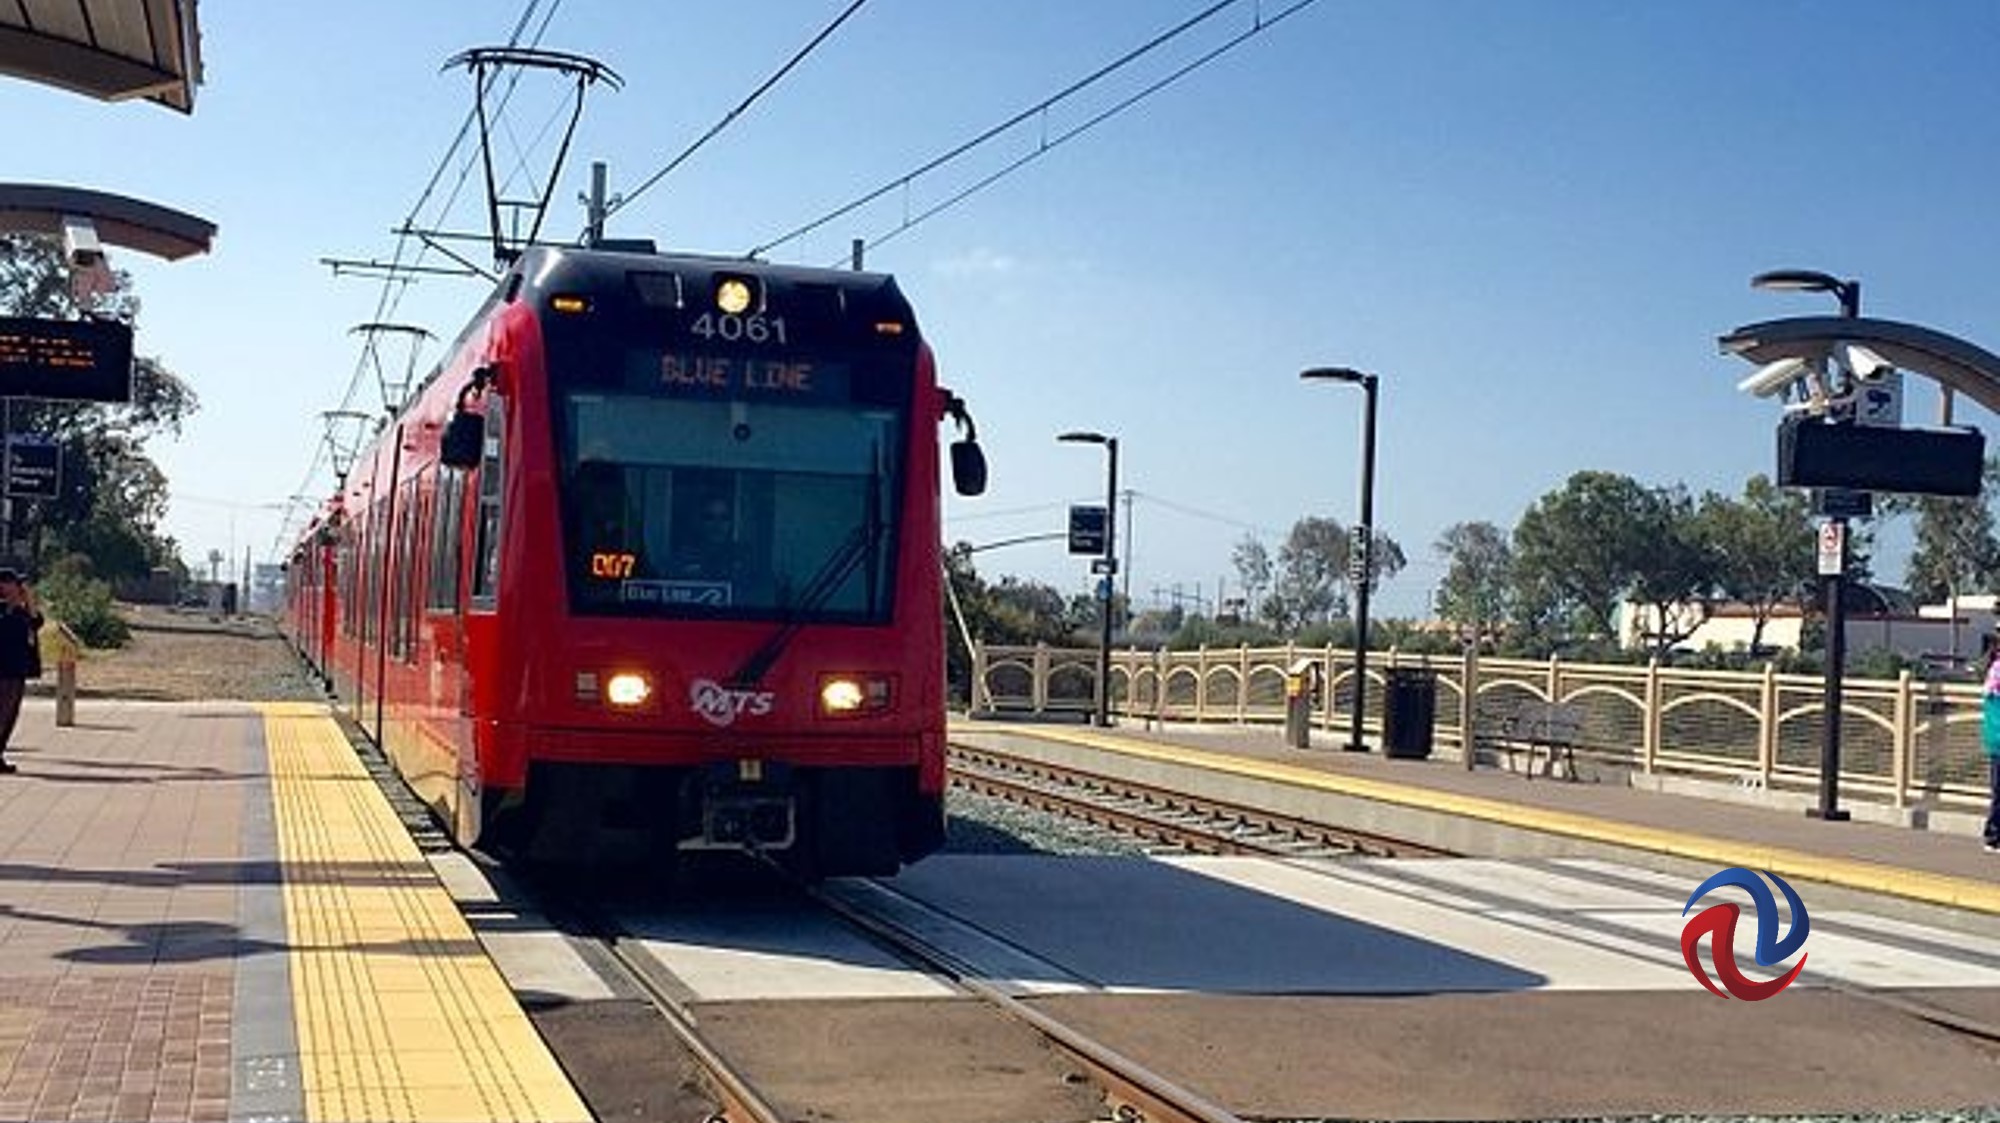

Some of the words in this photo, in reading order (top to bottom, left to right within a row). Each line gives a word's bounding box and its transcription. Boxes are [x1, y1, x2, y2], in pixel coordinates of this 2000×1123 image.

[691, 312, 786, 344] 4061
[661, 355, 730, 386] BLUE
[746, 360, 814, 391] LINE
